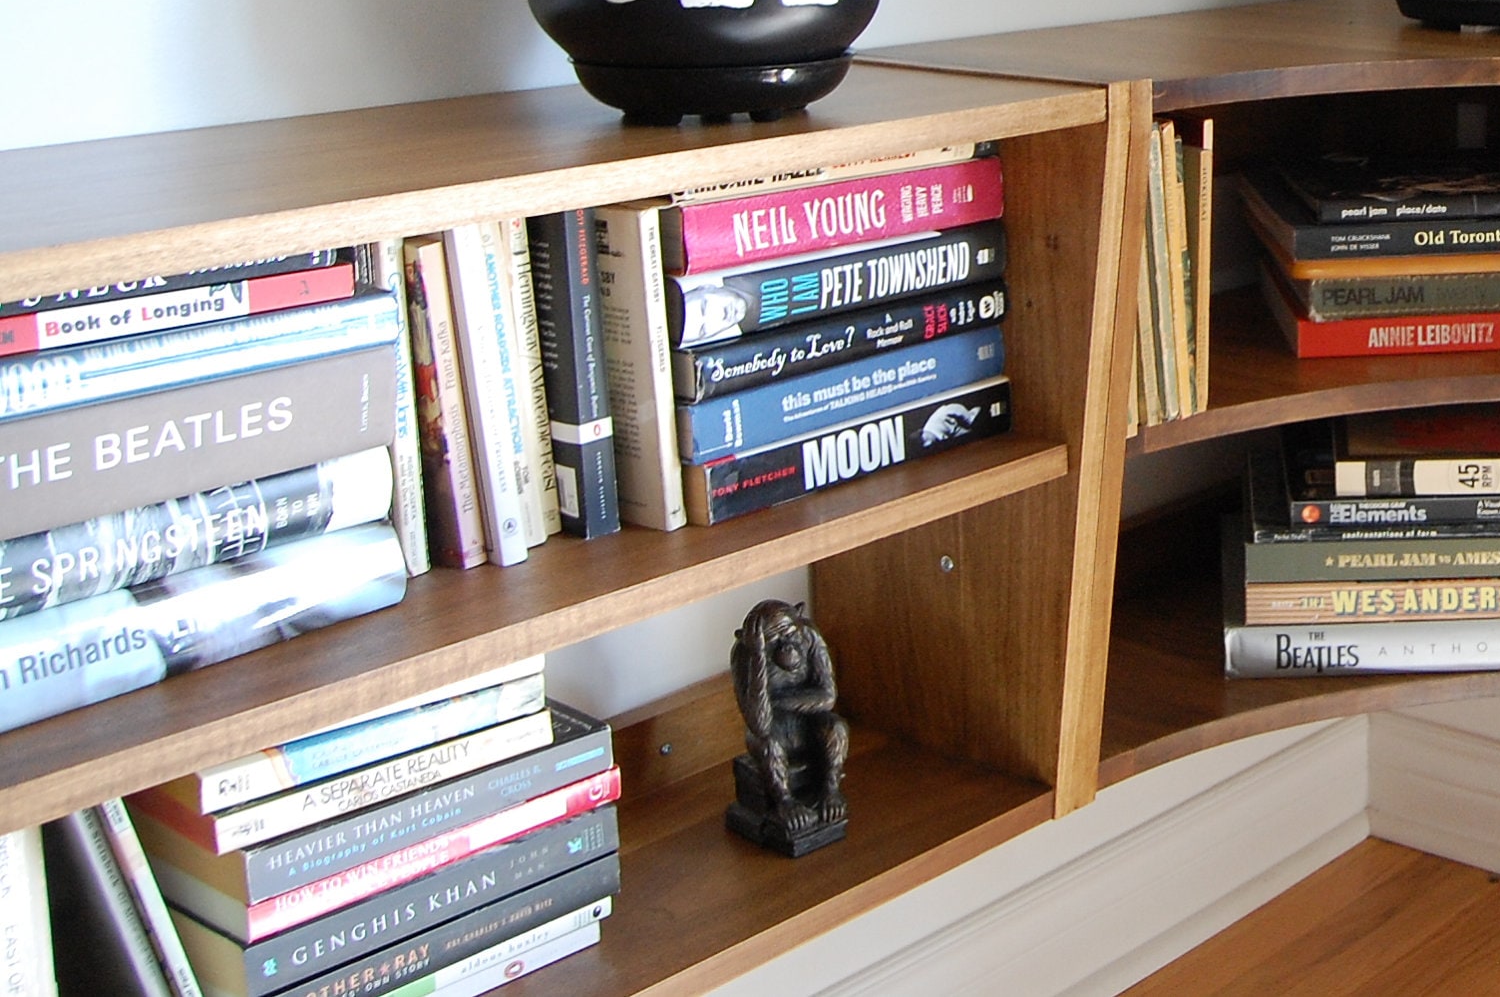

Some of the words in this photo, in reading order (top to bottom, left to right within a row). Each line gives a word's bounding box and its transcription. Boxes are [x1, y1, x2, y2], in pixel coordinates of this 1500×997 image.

[917, 186, 927, 217] HEAVY
[931, 183, 943, 214] PEACE
[1341, 207, 1367, 218] pearl
[1369, 207, 1387, 218] jam
[732, 206, 798, 257] NEIL
[803, 189, 886, 239] YOUNG
[1414, 231, 1445, 247] Old
[578, 229, 590, 285] FITZGERALD
[650, 244, 658, 271] GREAT
[652, 273, 660, 302] GATSBY
[791, 272, 820, 305] AM
[820, 261, 864, 311] PETE
[866, 242, 970, 298] TOWNSHEND
[759, 278, 788, 323] WHO
[1321, 288, 1380, 306] PEARL
[1385, 286, 1425, 304] JAM
[45, 314, 101, 337] Book
[110, 310, 131, 327] of
[141, 292, 225, 323] Longing
[867, 327, 884, 340] Rock
[899, 319, 913, 332] Roll
[936, 303, 947, 334] SLICK
[438, 320, 450, 350] Kafka
[877, 335, 904, 349] Memoir
[1368, 326, 1415, 348] ANNIE
[1416, 322, 1494, 346] LEIBOVITZ
[486, 253, 501, 309] ANOTHER
[494, 314, 510, 373] ROADSIDE
[503, 378, 522, 454] ATTRACTION
[707, 348, 788, 382] Somebody
[791, 347, 805, 362] to
[805, 327, 856, 359] Love?
[443, 356, 455, 390] Franz
[517, 260, 537, 351] Hemingway
[541, 452, 554, 491] Feast
[781, 388, 811, 413] this
[813, 379, 851, 404] must
[852, 373, 871, 391] be
[873, 366, 897, 386] the
[898, 356, 937, 384] place
[94, 396, 292, 471] BEATLES
[451, 404, 470, 489] Metamorphosis
[802, 415, 905, 491] MOON
[712, 482, 739, 499] TONY
[742, 466, 797, 490] FLETCHER
[1458, 463, 1480, 489] 45
[1482, 465, 1493, 487] RPM
[276, 496, 288, 528] BORN
[462, 490, 473, 513] The
[1340, 505, 1427, 523] Elements
[32, 505, 267, 593] SPRINGSTEEN
[1338, 554, 1398, 568] PEARL
[1400, 553, 1436, 567] JAM
[1453, 552, 1500, 565] AMES
[1332, 589, 1396, 617] WES
[1309, 632, 1325, 641] THE
[18, 625, 149, 682] Richards
[1276, 634, 1360, 672] BEATLES
[302, 794, 317, 811] A
[320, 765, 402, 804] SEPARATE
[407, 740, 471, 774] REALITY
[377, 770, 442, 797] CASTANEDA
[488, 769, 531, 792] CHARLES
[501, 779, 533, 798] CROSS
[268, 832, 347, 871] HEAVIER
[352, 811, 402, 844] THAN
[410, 785, 475, 822] HEAVEN
[288, 866, 298, 876] A
[303, 844, 367, 872] Biography
[372, 835, 385, 848] of
[389, 822, 417, 842] Kurt
[421, 807, 462, 829] Cobain
[92, 831, 119, 887] Steinbeck
[343, 859, 379, 886] WIN
[510, 845, 551, 869] JOHN
[515, 862, 546, 880] MAN
[291, 905, 418, 966] GENGHIS
[428, 871, 497, 911] KHAN
[395, 943, 430, 966] RAY
[461, 951, 503, 974] aldous
[508, 931, 550, 955] huxley
[366, 976, 390, 990] OWN
[395, 958, 430, 980] STORY
